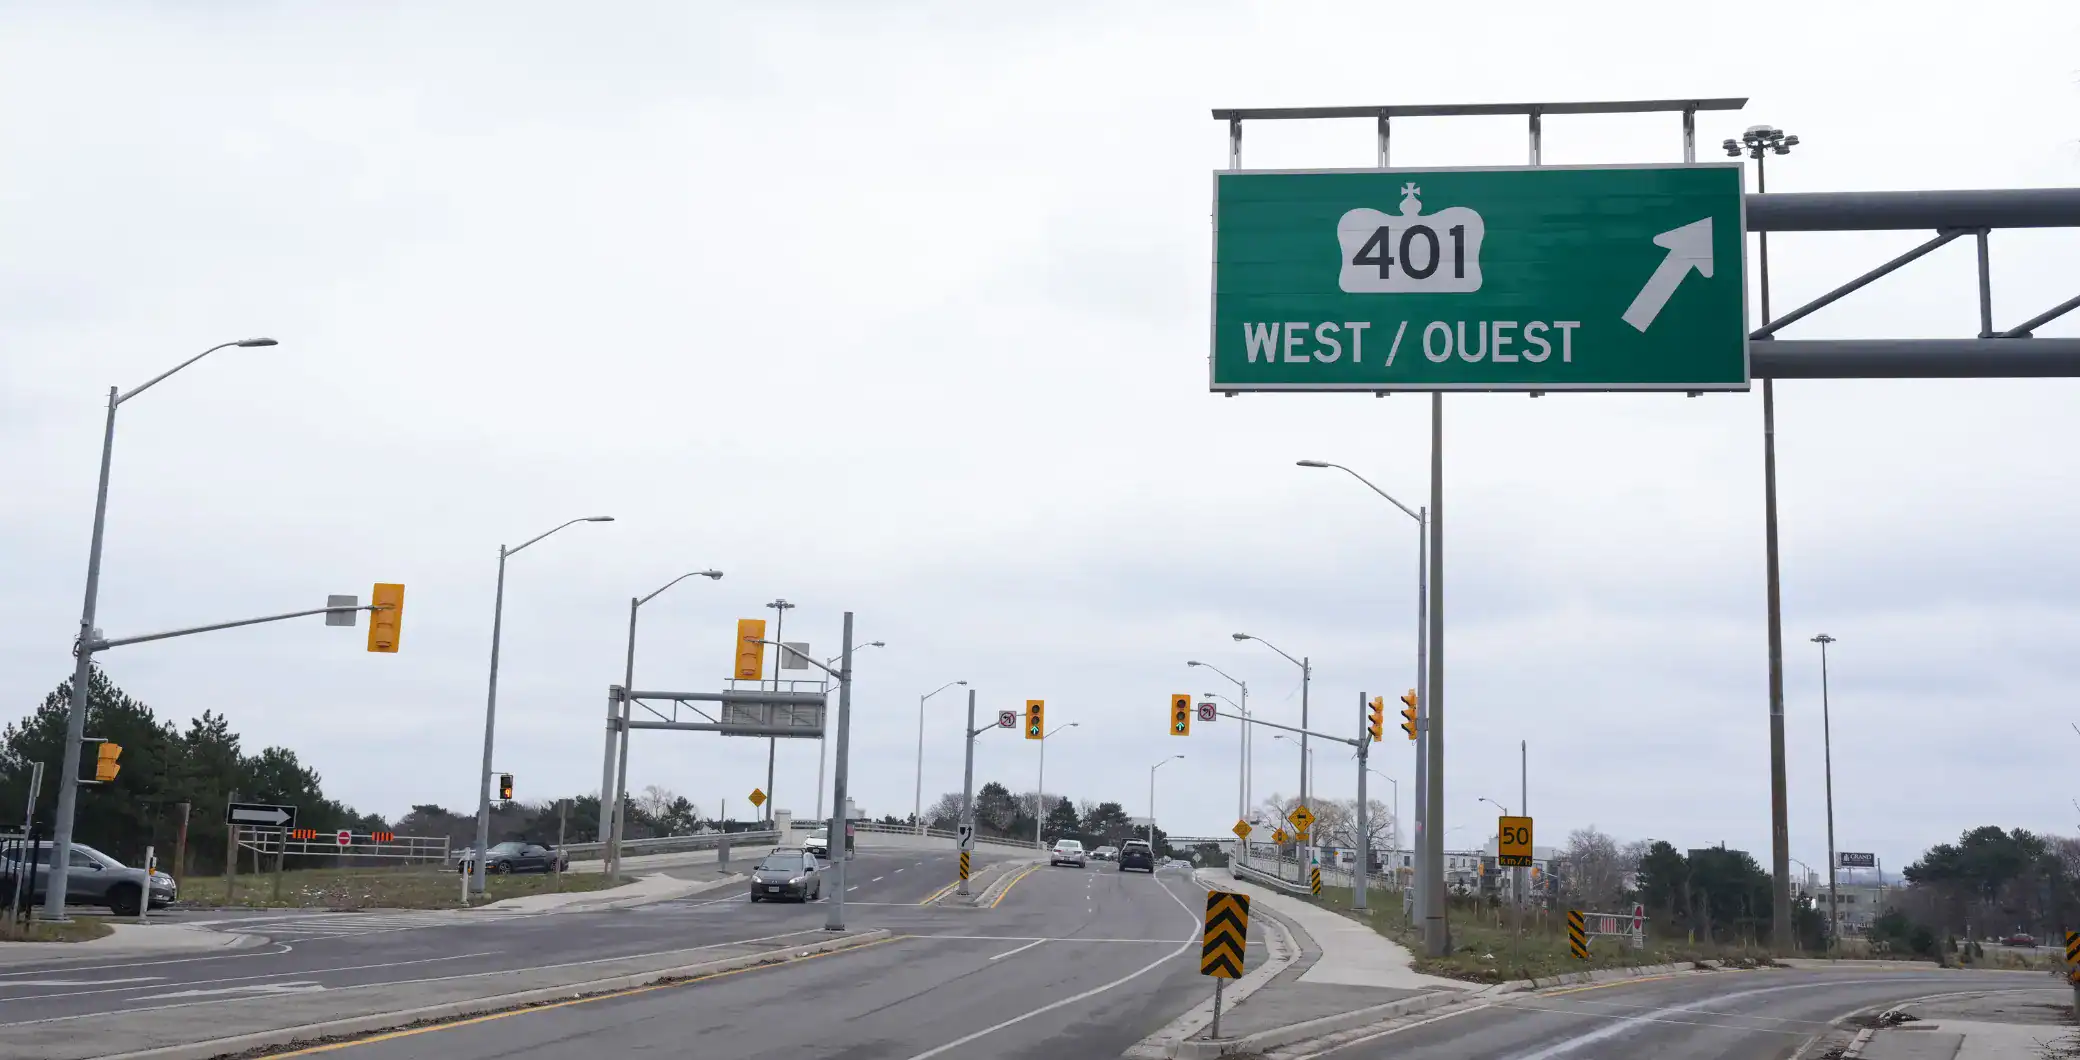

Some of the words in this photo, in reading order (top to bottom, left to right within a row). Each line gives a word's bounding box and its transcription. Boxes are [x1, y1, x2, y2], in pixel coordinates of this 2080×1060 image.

[1352, 224, 1465, 279] 401
[1243, 321, 1371, 364] WEST
[1384, 320, 1408, 367] /
[1422, 320, 1581, 364] OUEST
[1503, 827, 1529, 845] 50
[1501, 857, 1531, 865] km/h
